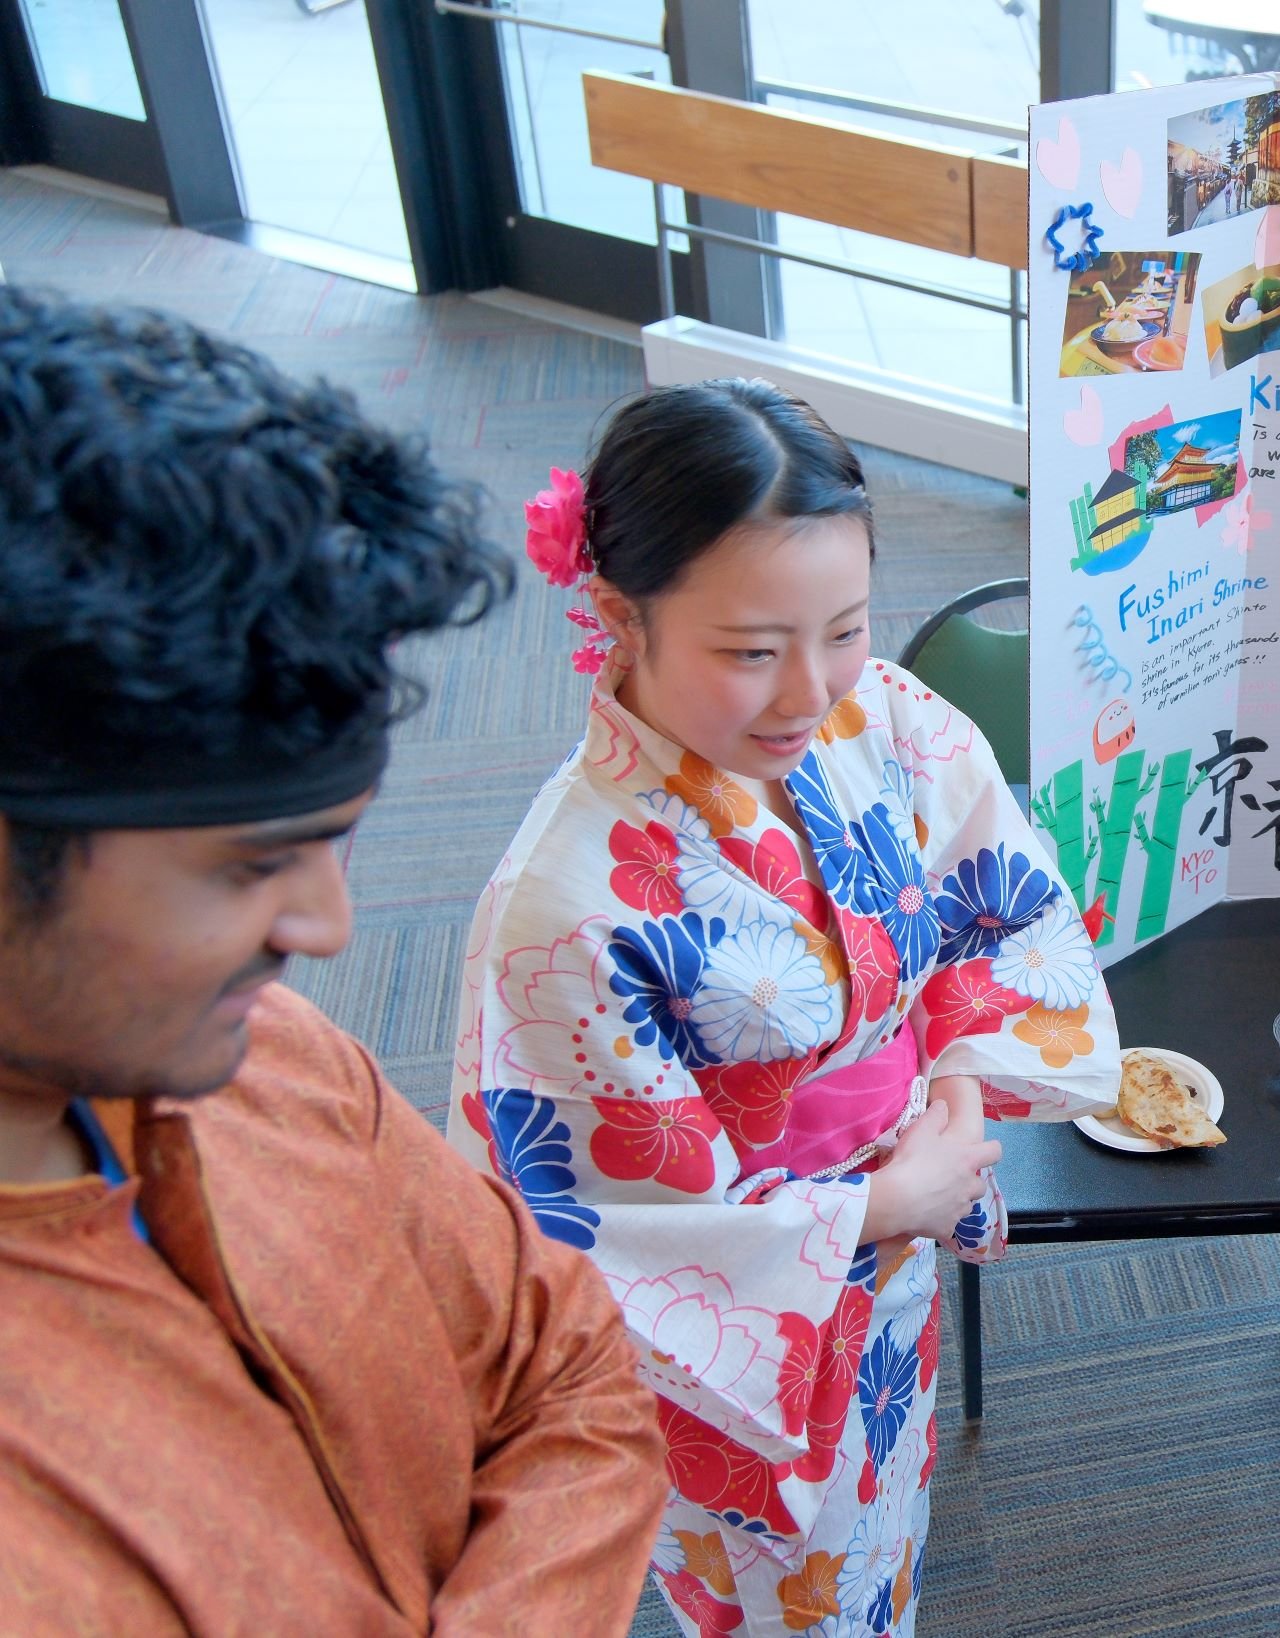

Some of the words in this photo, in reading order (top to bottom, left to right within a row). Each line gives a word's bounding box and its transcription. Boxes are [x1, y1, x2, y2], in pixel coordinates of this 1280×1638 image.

[1249, 467, 1276, 479] are
[1119, 561, 1209, 632] Fushimi
[1147, 598, 1203, 644] Inari
[1213, 576, 1269, 606] Shrine
[1141, 661, 1150, 673] is
[1152, 654, 1165, 669] an
[1170, 618, 1221, 655] important
[1226, 603, 1267, 623] Shinto
[1141, 667, 1167, 688] shrine
[1171, 659, 1180, 669] in
[1142, 685, 1159, 705] It's
[1160, 672, 1189, 696] famous
[1193, 661, 1204, 677] for
[1209, 651, 1221, 665] its
[1225, 632, 1279, 655] thousands
[1158, 696, 1169, 711] of
[1181, 849, 1214, 882] KYO
[1188, 868, 1217, 895] TO
